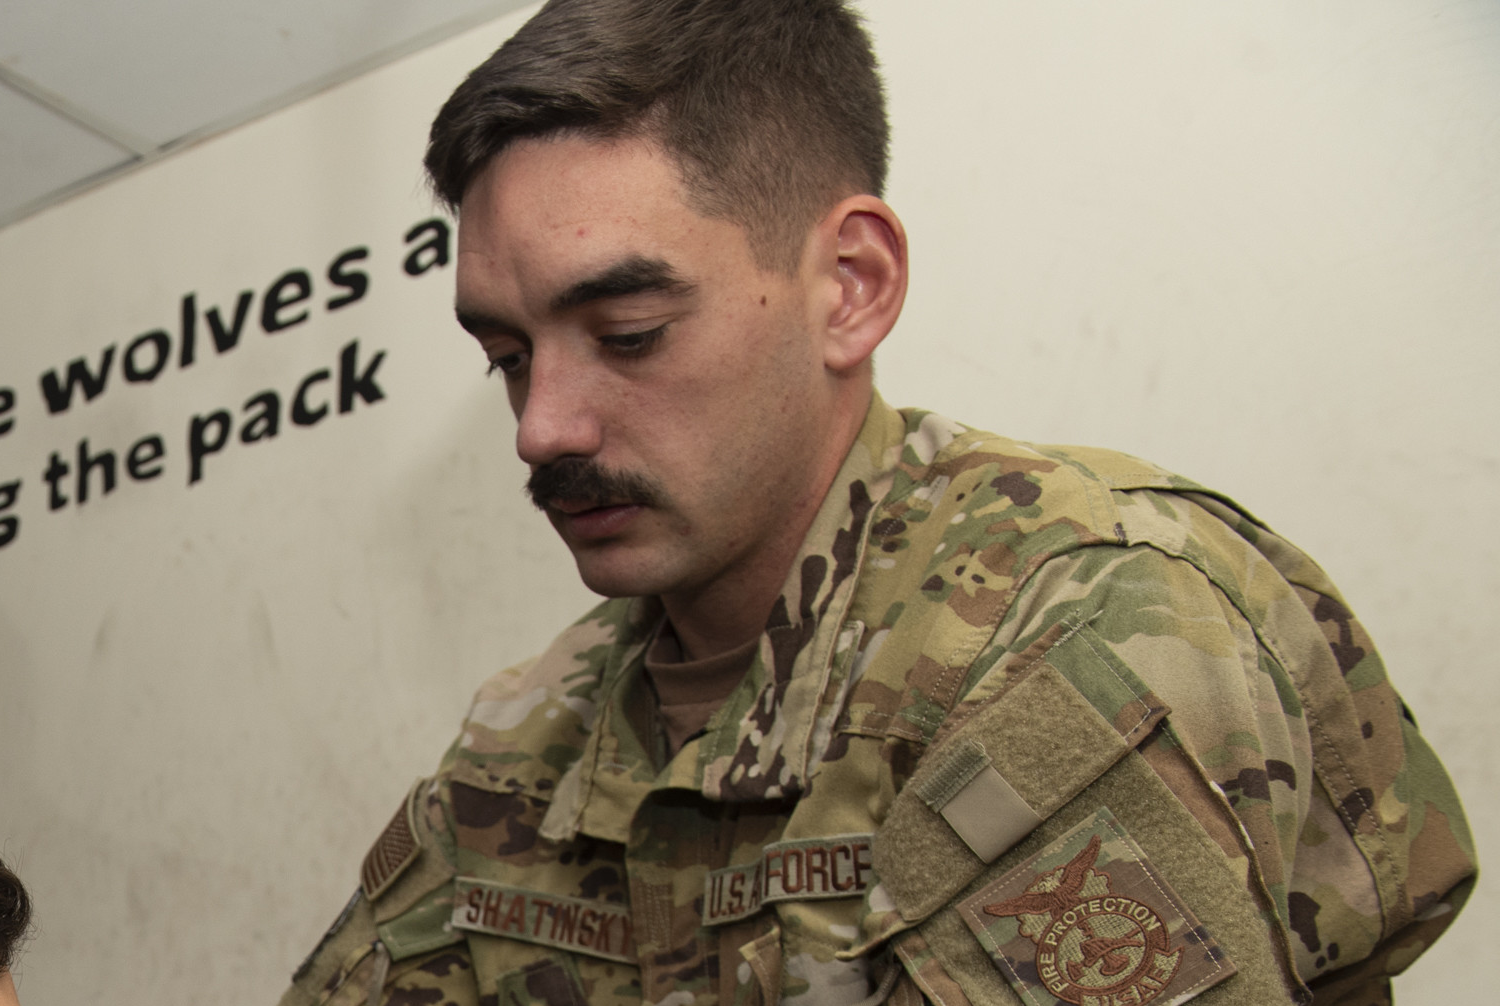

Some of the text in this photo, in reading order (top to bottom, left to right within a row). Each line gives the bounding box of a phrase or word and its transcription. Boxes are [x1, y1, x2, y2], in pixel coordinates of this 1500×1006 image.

[38, 246, 370, 415] wolves
[43, 435, 166, 512] the
[187, 339, 387, 486] pack
[764, 843, 872, 897] FORCE
[1040, 897, 1162, 993] FIRE PROTECTION
